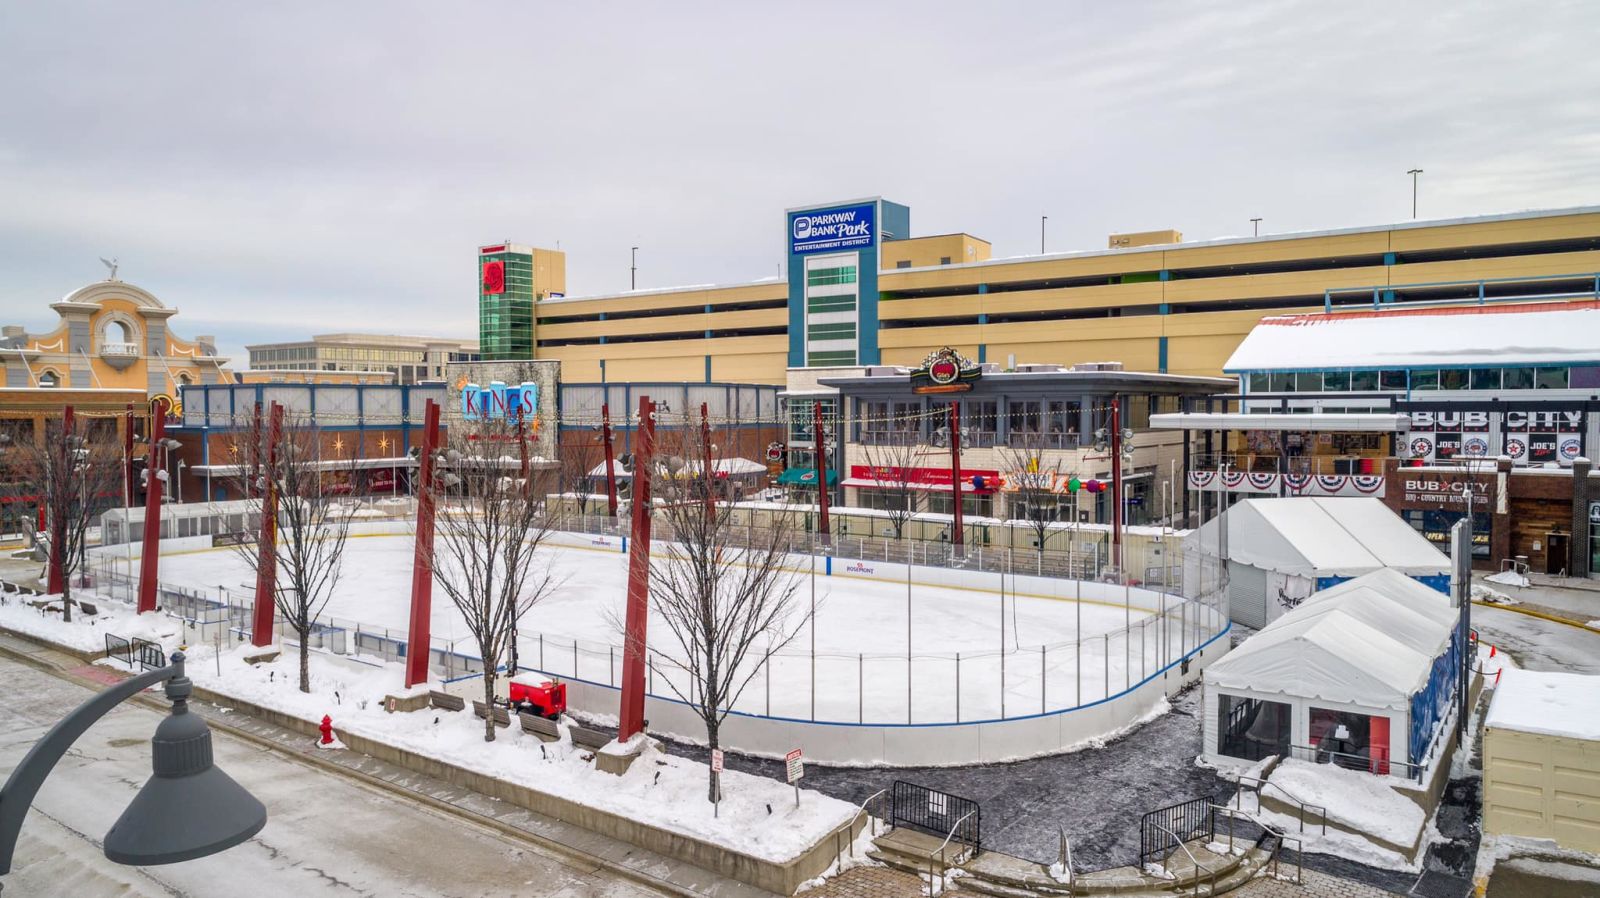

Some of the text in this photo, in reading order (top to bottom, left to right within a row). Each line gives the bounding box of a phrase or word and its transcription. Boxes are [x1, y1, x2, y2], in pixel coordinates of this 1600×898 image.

[811, 211, 856, 226] PARKWAY
[811, 220, 870, 237] BANK Park
[795, 239, 870, 251] ENTERTAINMENT DISTRICT
[466, 390, 533, 417] KINGS
[1411, 410, 1582, 427] BUB CITY
[1437, 441, 1461, 449] JOE'S
[1530, 442, 1556, 450] JOE'S
[1405, 480, 1440, 491] BUB
[1420, 494, 1448, 503] COUNTRY
[846, 566, 874, 574] ROSEMONT
